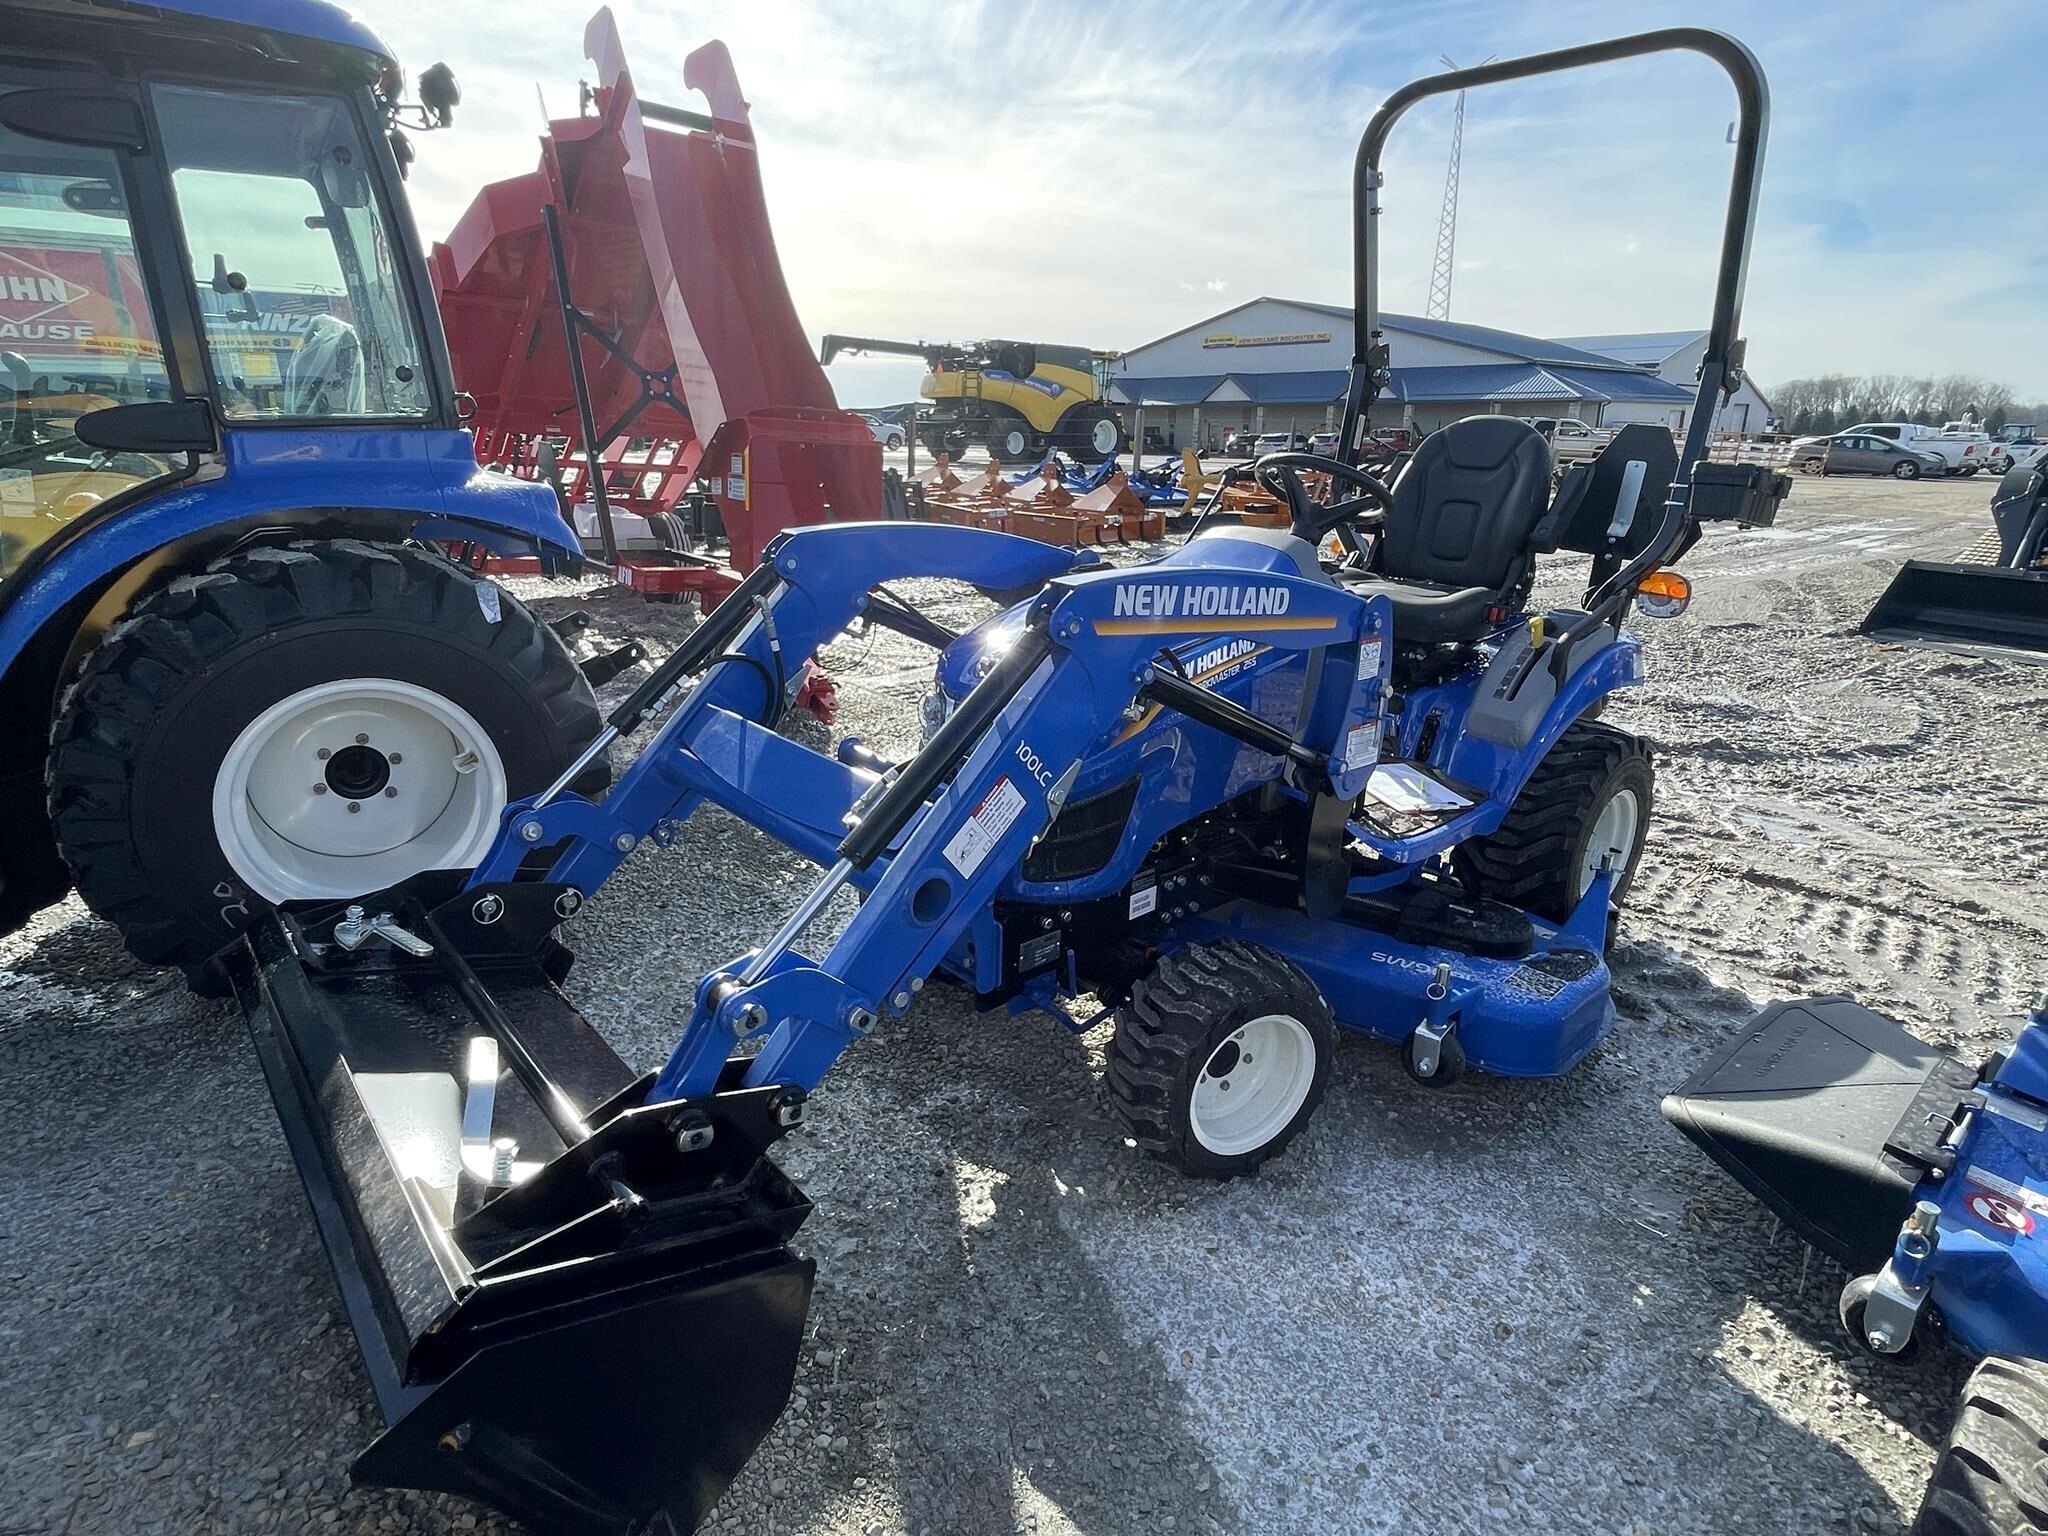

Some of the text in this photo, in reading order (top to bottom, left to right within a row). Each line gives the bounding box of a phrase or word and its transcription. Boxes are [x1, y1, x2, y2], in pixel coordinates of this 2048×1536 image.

[1113, 584, 1290, 617] NEW HOLLAND
[1197, 639, 1256, 675] HOLLAND
[1199, 664, 1240, 689] RKMASTER
[1015, 739, 1053, 788] 100LC
